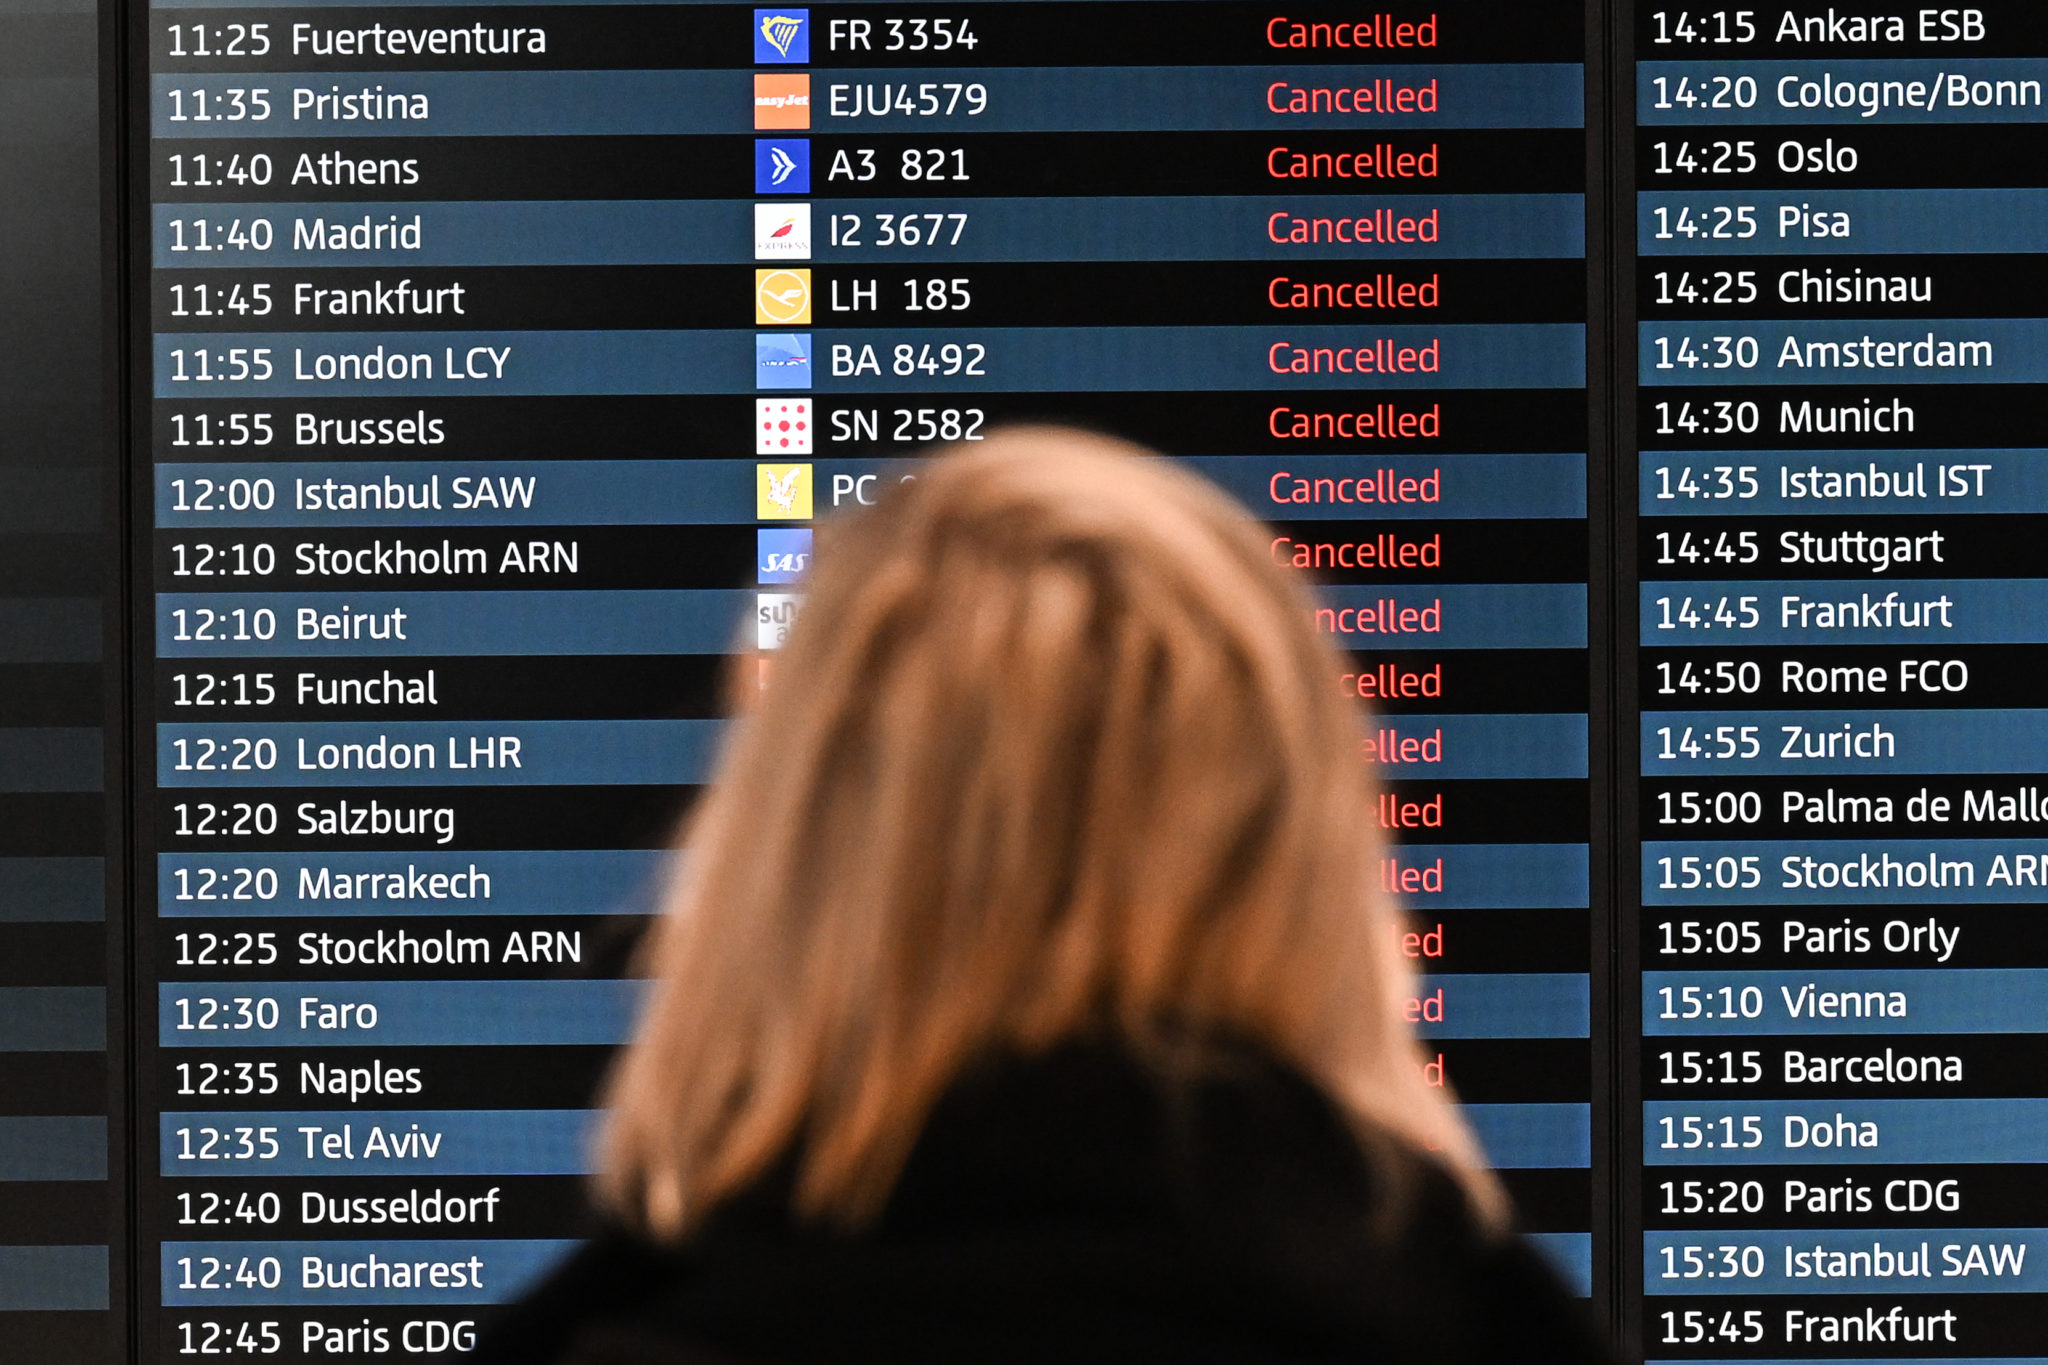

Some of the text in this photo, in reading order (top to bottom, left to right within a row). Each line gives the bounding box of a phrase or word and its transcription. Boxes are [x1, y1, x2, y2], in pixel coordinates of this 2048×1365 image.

[167, 13, 1437, 57] 11:25 Fuerteventura FR 3354 Cancelled
[1652, 7, 1986, 44] 14:15 Ankara ESB
[168, 78, 1438, 122] 11:35 Pristina EJU4579 Cancelled
[1653, 72, 2041, 118] 14:20 Cologne/Bonn
[168, 143, 1438, 186] 11:40 Athens A3 821 Cancelled
[1653, 138, 1858, 174] 14:25 Oslo
[169, 208, 1439, 252] 11:40 Madrid I2 3677 Cancelled
[1653, 203, 1850, 239] 14:25 Pisa
[169, 273, 1439, 316] 11:45 Frankfurt LH 185 Cancelled
[1654, 267, 1932, 304] 14:25 Chisinau
[170, 338, 1440, 381] 11:55 London LCY BA 8492 Cancelled
[1654, 332, 1993, 369] 14:30 Amsterdam
[170, 403, 1440, 446] 11:55 Brussels SN 2582 Cancelled
[1655, 397, 1914, 434] 14:30 Munich
[171, 468, 1440, 511] 12:00 Istanbul SAW PC Cancelled
[1655, 462, 1992, 499] 14:35 Istanbul IST
[172, 534, 1440, 576] 12:10 Stockholm ARN Cancelled
[761, 554, 808, 572] SAS
[1656, 530, 1945, 573] 14:45 Stuttgart
[172, 599, 1441, 641] 12:10 Beirut ncelled
[1656, 591, 1953, 629] 14:45 Frankfurt
[173, 664, 1441, 706] 12:15 Funchal celled
[1656, 660, 1968, 694] 14:50 Rome FCO
[173, 729, 1442, 771] 12:20 London LHR elled
[1657, 722, 1895, 759] 14:55 Zurich
[174, 799, 454, 844] 12:20 Salzburg
[1657, 791, 1762, 824] 15:00
[1783, 788, 1893, 824] Palma
[1906, 787, 1951, 822] de
[174, 863, 491, 901] 12:20 Marrakech
[1657, 856, 1761, 889] 15:05
[1781, 852, 1975, 889] Stockholm
[175, 929, 581, 965] 12:25 Stockholm ARN
[1658, 917, 1961, 963] 15:05 Paris Orly
[175, 997, 378, 1030] 12:30 Faro
[1658, 983, 1907, 1019] 15:10 Vienna
[176, 1059, 422, 1103] 12:35 Naples
[1659, 1047, 1963, 1084] 15:15 Barcelona
[176, 1123, 442, 1160] 12:35 Tel Aviv
[1659, 1112, 1878, 1149] 15:15 Doha
[177, 1187, 500, 1225] 12:40 Dusseldorf
[1660, 1177, 1960, 1214] 15:20 Paris CDG
[177, 1253, 484, 1289] 12:40 Bucharest
[1660, 1241, 2026, 1279] 15:30 Istanbul SAW
[178, 1318, 476, 1354] 12:45 Paris CDG
[1660, 1306, 1957, 1343] 15:45 Frankfurt
